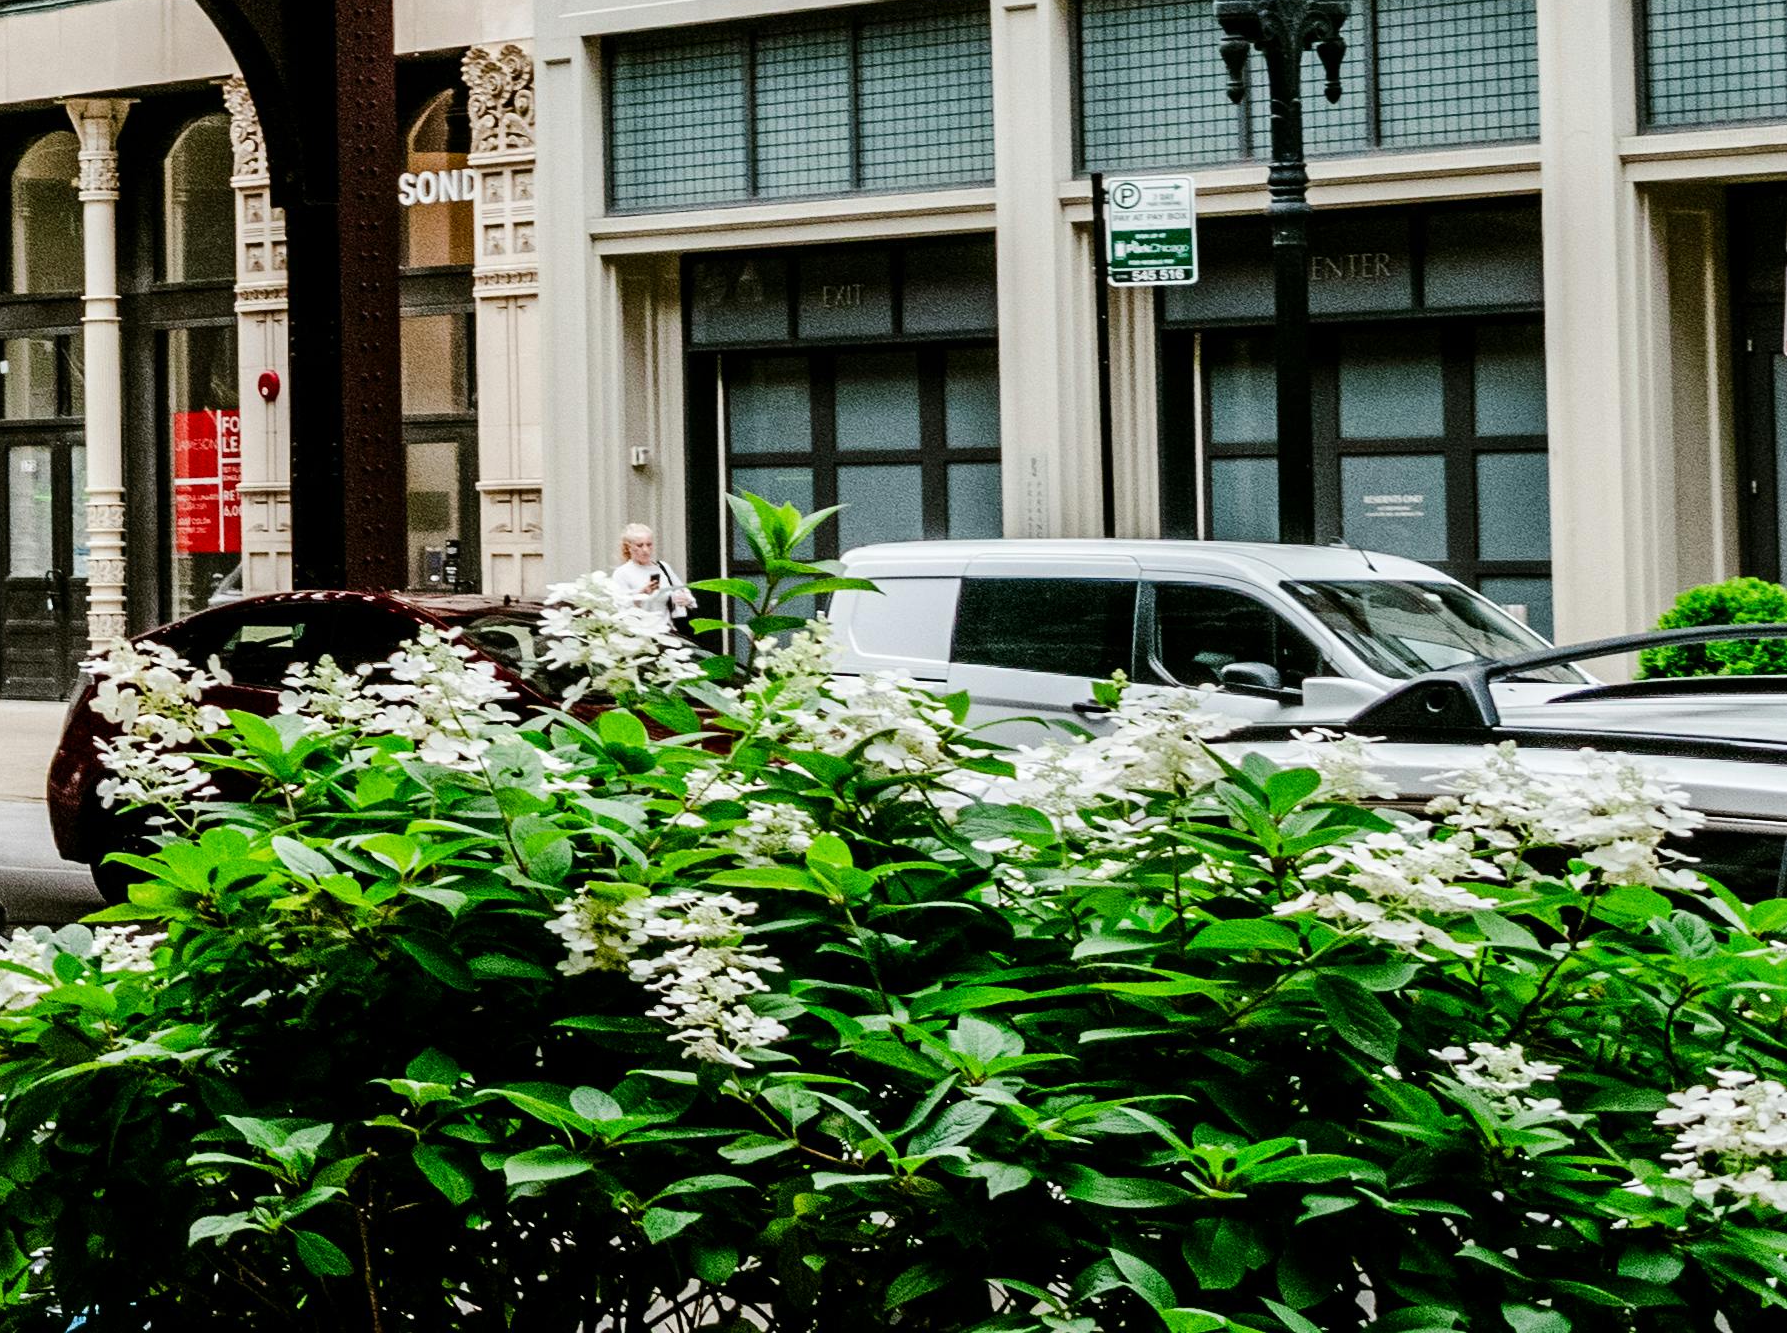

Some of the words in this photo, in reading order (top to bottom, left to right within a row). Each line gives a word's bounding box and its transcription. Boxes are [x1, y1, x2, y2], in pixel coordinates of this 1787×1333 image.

[398, 169, 474, 206] SOND
[1131, 270, 1157, 282] 545
[1159, 268, 1185, 281] 516
[1311, 253, 1392, 281] ENTER
[822, 284, 862, 308] EXIT
[222, 416, 240, 433] FO
[222, 436, 239, 453] LE
